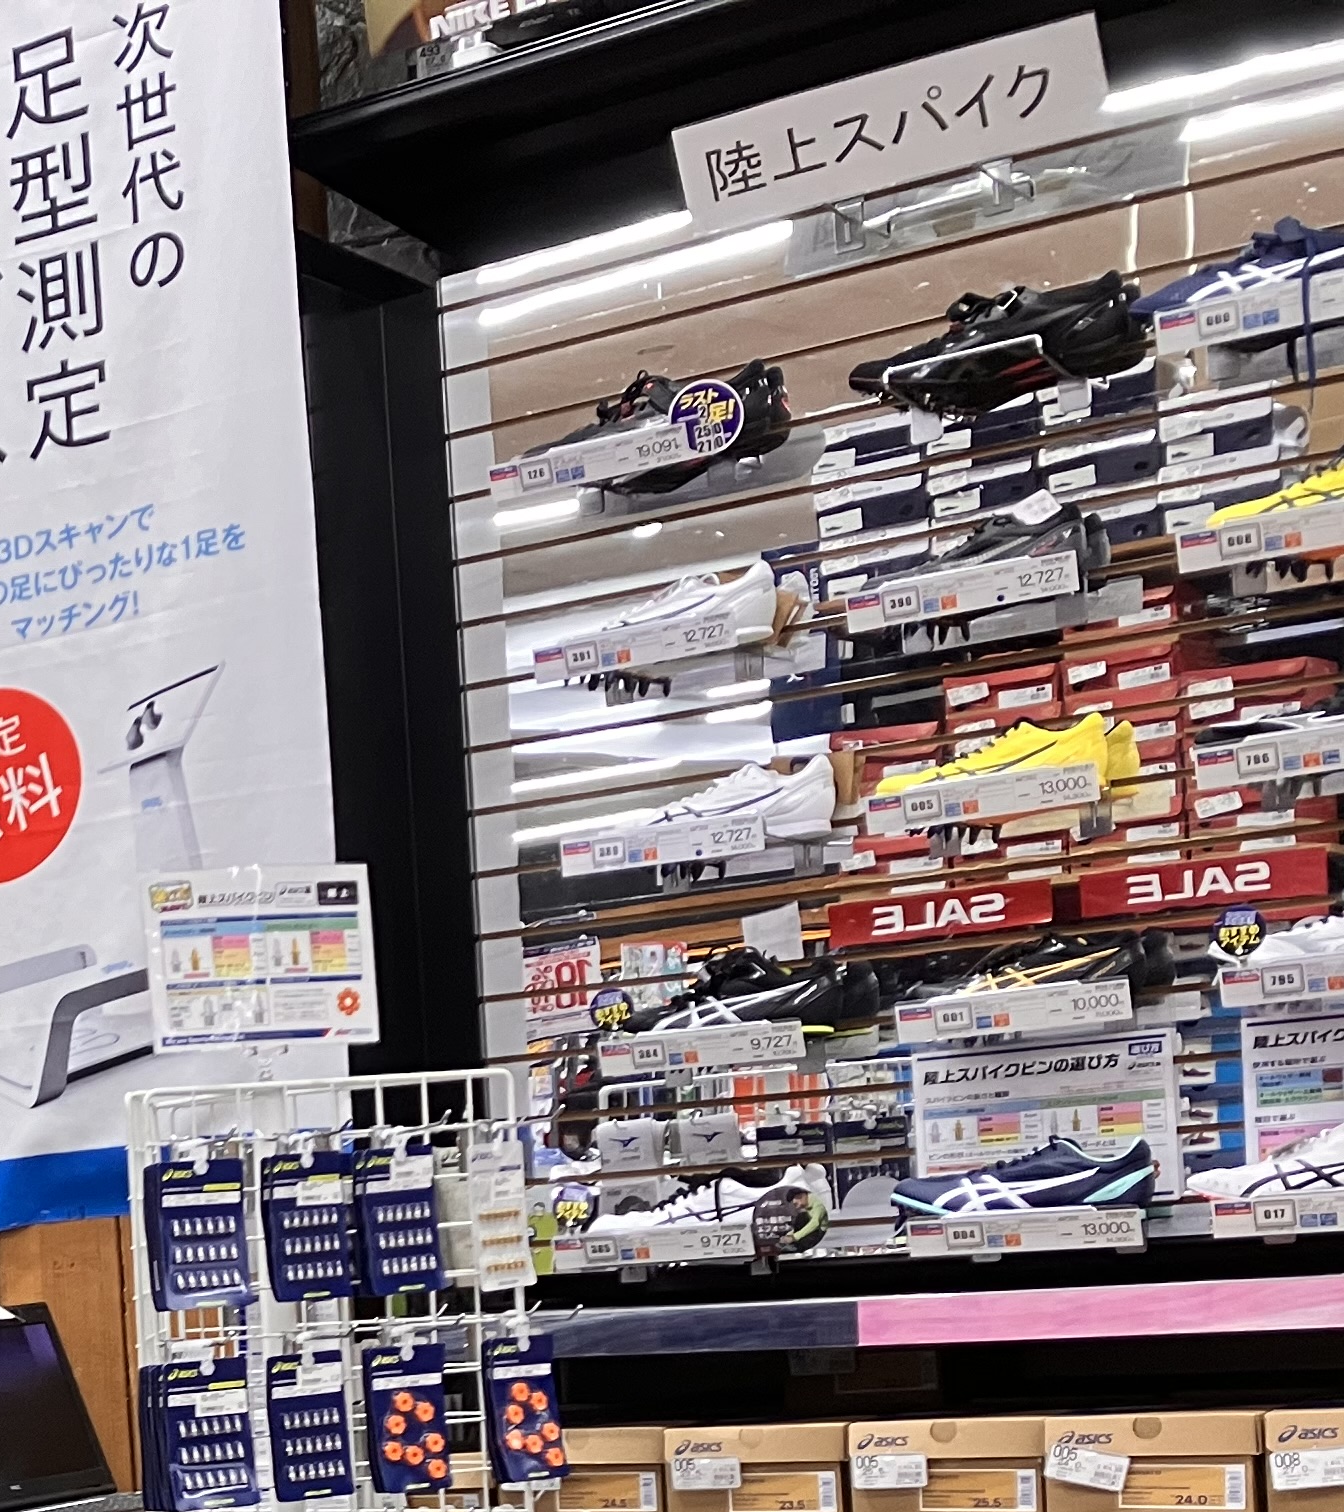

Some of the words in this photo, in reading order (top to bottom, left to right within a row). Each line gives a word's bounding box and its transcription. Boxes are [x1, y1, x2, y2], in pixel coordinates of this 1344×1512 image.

[429, 0, 510, 39] NIKE
[113, 2, 184, 288] 次世代の
[703, 62, 1051, 202] 陸上スパイク
[6, 26, 111, 461] 足型測定
[679, 388, 719, 411] ラスト
[13, 590, 140, 642] マッチング!
[1275, 1452, 1300, 1468] 008
[1174, 1495, 1208, 1506] 24.0
